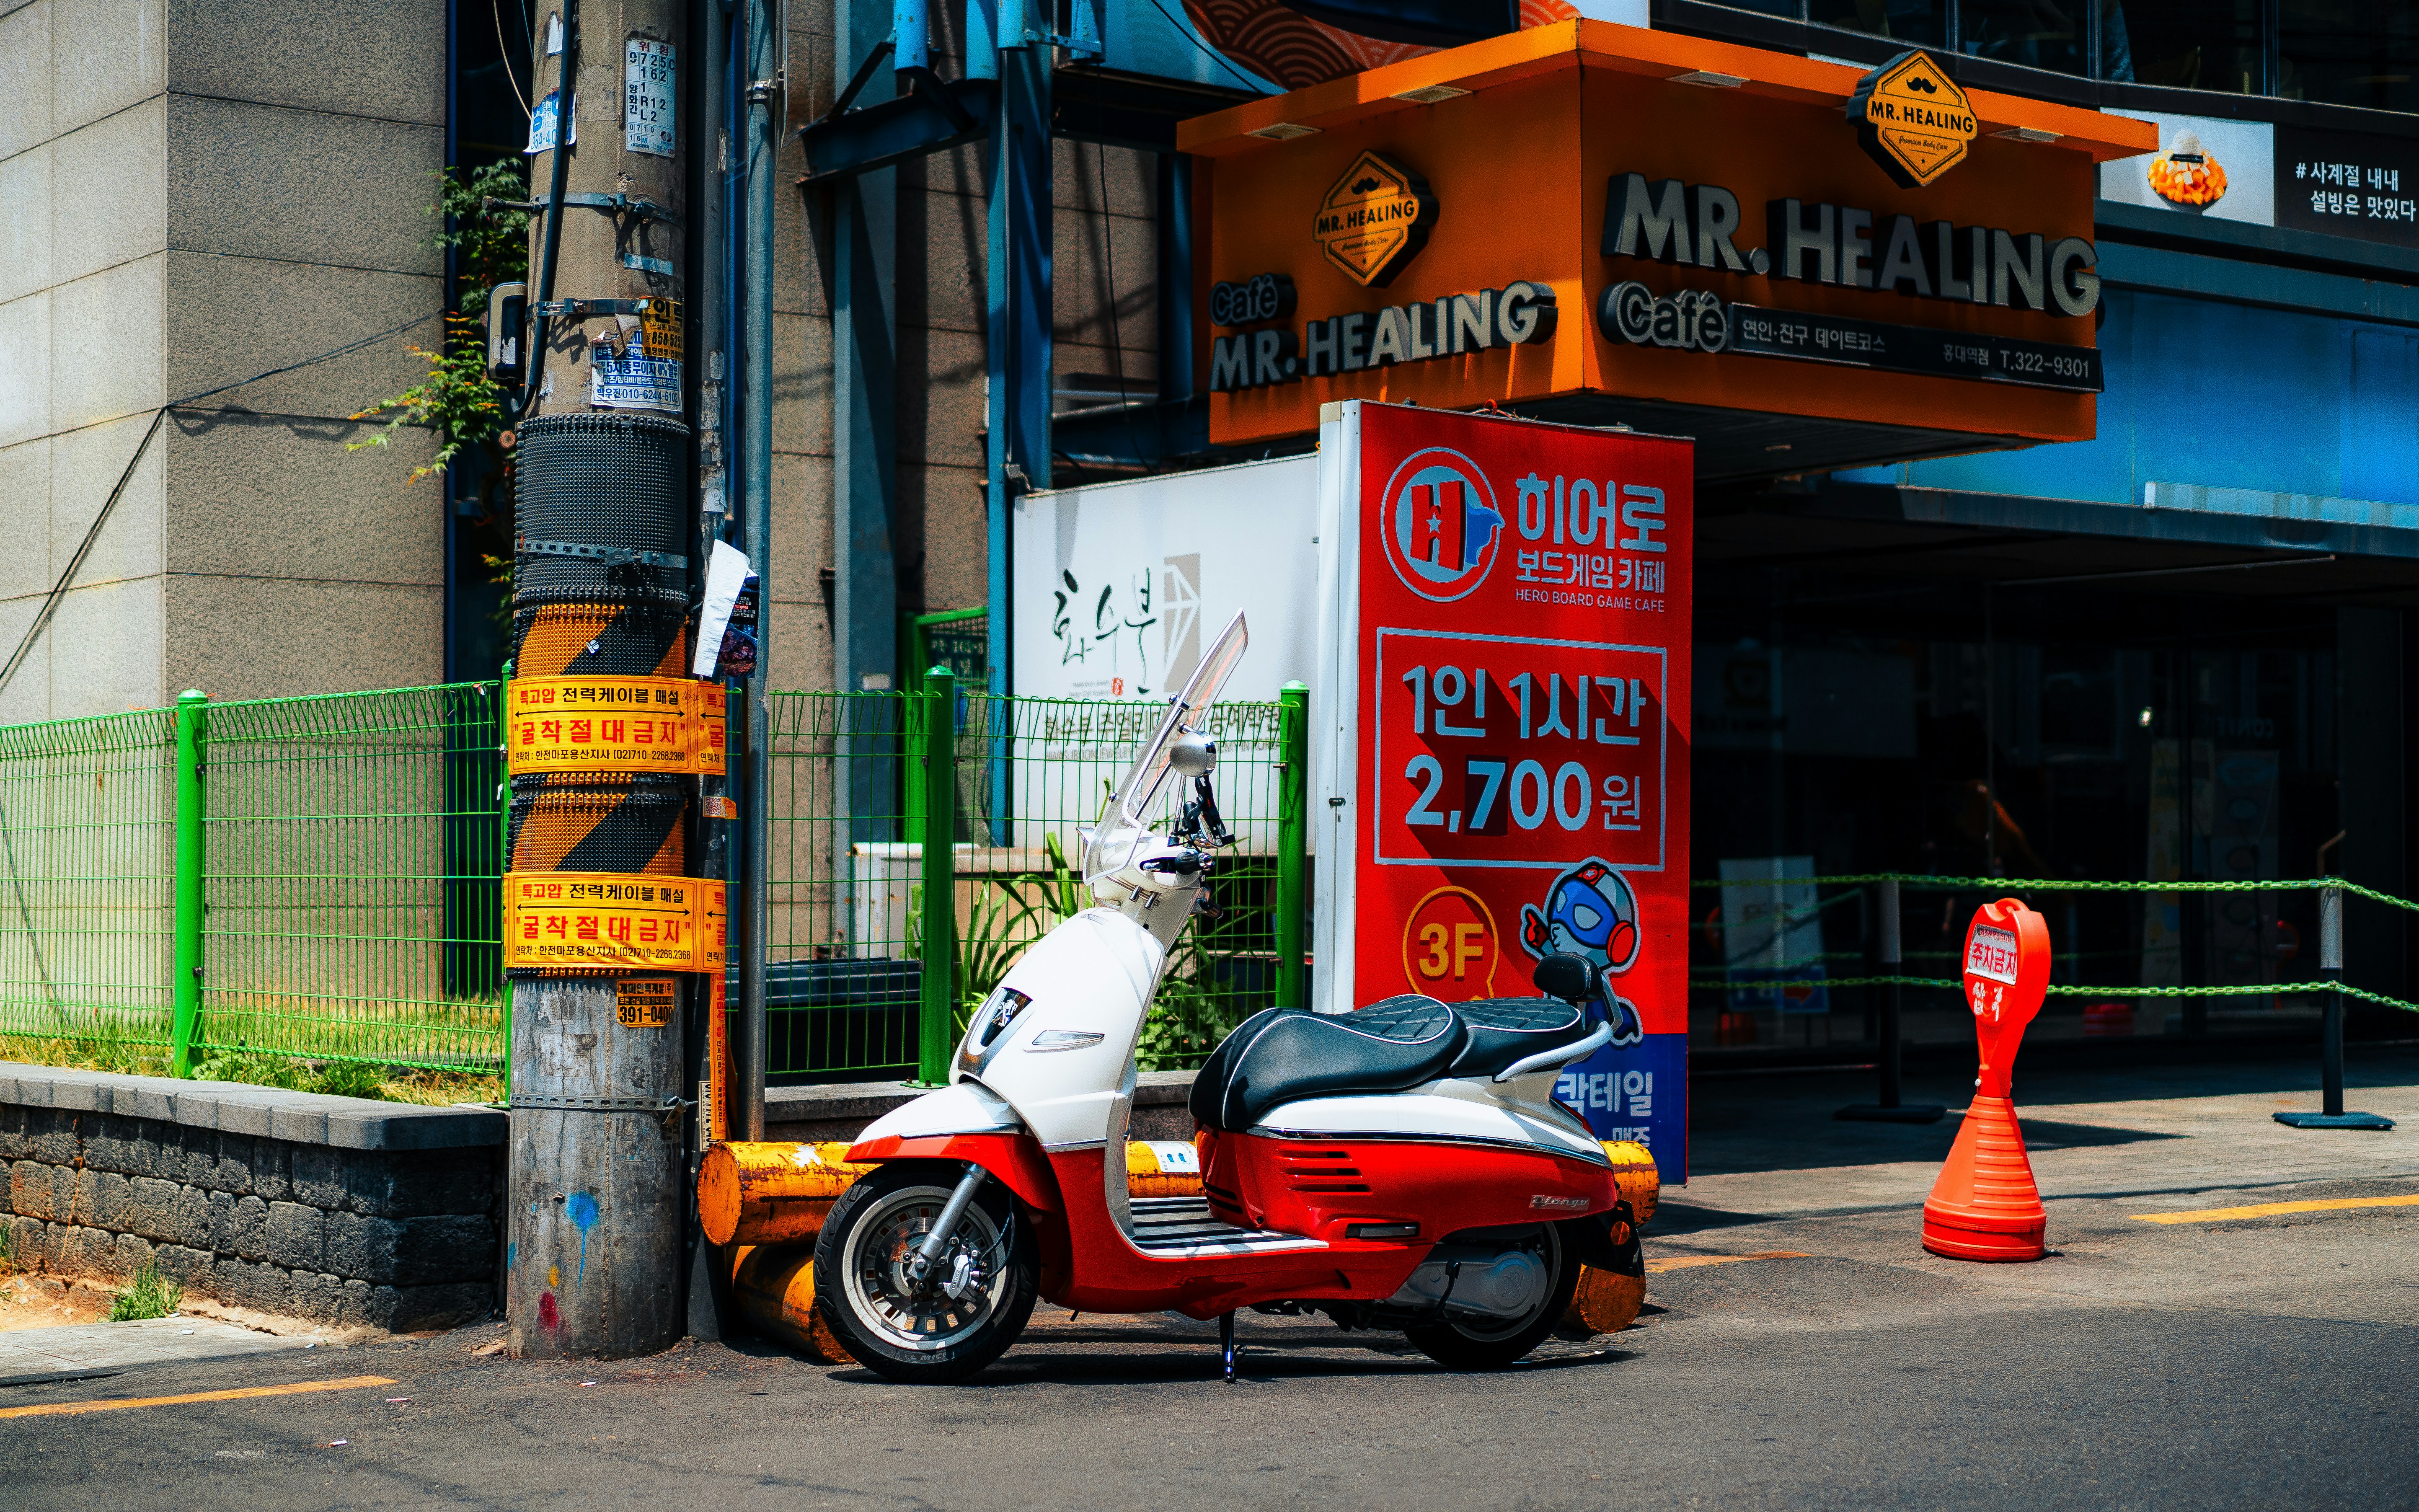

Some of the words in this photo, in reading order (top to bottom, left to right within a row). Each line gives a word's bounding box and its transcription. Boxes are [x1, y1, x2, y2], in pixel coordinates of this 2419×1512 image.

[1871, 101, 1900, 121] MR.
[1904, 106, 1973, 133] HEALING
[2310, 162, 2360, 187] 사계절
[2367, 167, 2398, 192] 내내
[1318, 213, 1344, 235] MR.
[1346, 200, 1415, 228] HEALING
[2310, 191, 2360, 216] 설빙은
[2367, 196, 2416, 222] 맛있다
[1609, 172, 1770, 276] MR.
[1782, 197, 2102, 318] HEALING
[1210, 272, 1279, 327] Café
[1616, 280, 1729, 354] Café
[1209, 329, 1298, 392] MR.
[1307, 280, 1543, 378] HEALING
[1815, 328, 1886, 354] 데이트코스
[1515, 472, 1667, 553] 히어로
[1516, 548, 1613, 590] 보드게임
[1618, 558, 1665, 594] 카페
[1515, 588, 1548, 604] HERO
[1552, 590, 1594, 607] BOARD
[1597, 594, 1631, 610] GAME
[1635, 598, 1665, 613] CAFE
[520, 688, 555, 705] 특고압
[562, 687, 649, 703] 전력케이블
[655, 689, 678, 706] 매설
[1402, 665, 1486, 738] 1인
[1508, 672, 1646, 746] 1시간
[535, 749, 610, 760] 한전마포용산지사
[1404, 754, 1592, 833] 2,700
[1600, 775, 1641, 832] 원
[522, 883, 562, 899] 특고압
[569, 884, 654, 902] 전력케이블
[660, 887, 684, 904] 매설
[539, 945, 616, 957] 한전마포용산지사
[1418, 922, 1484, 981] 3F
[1972, 942, 2017, 978] 주차금지
[1532, 1195, 1588, 1207] Django
